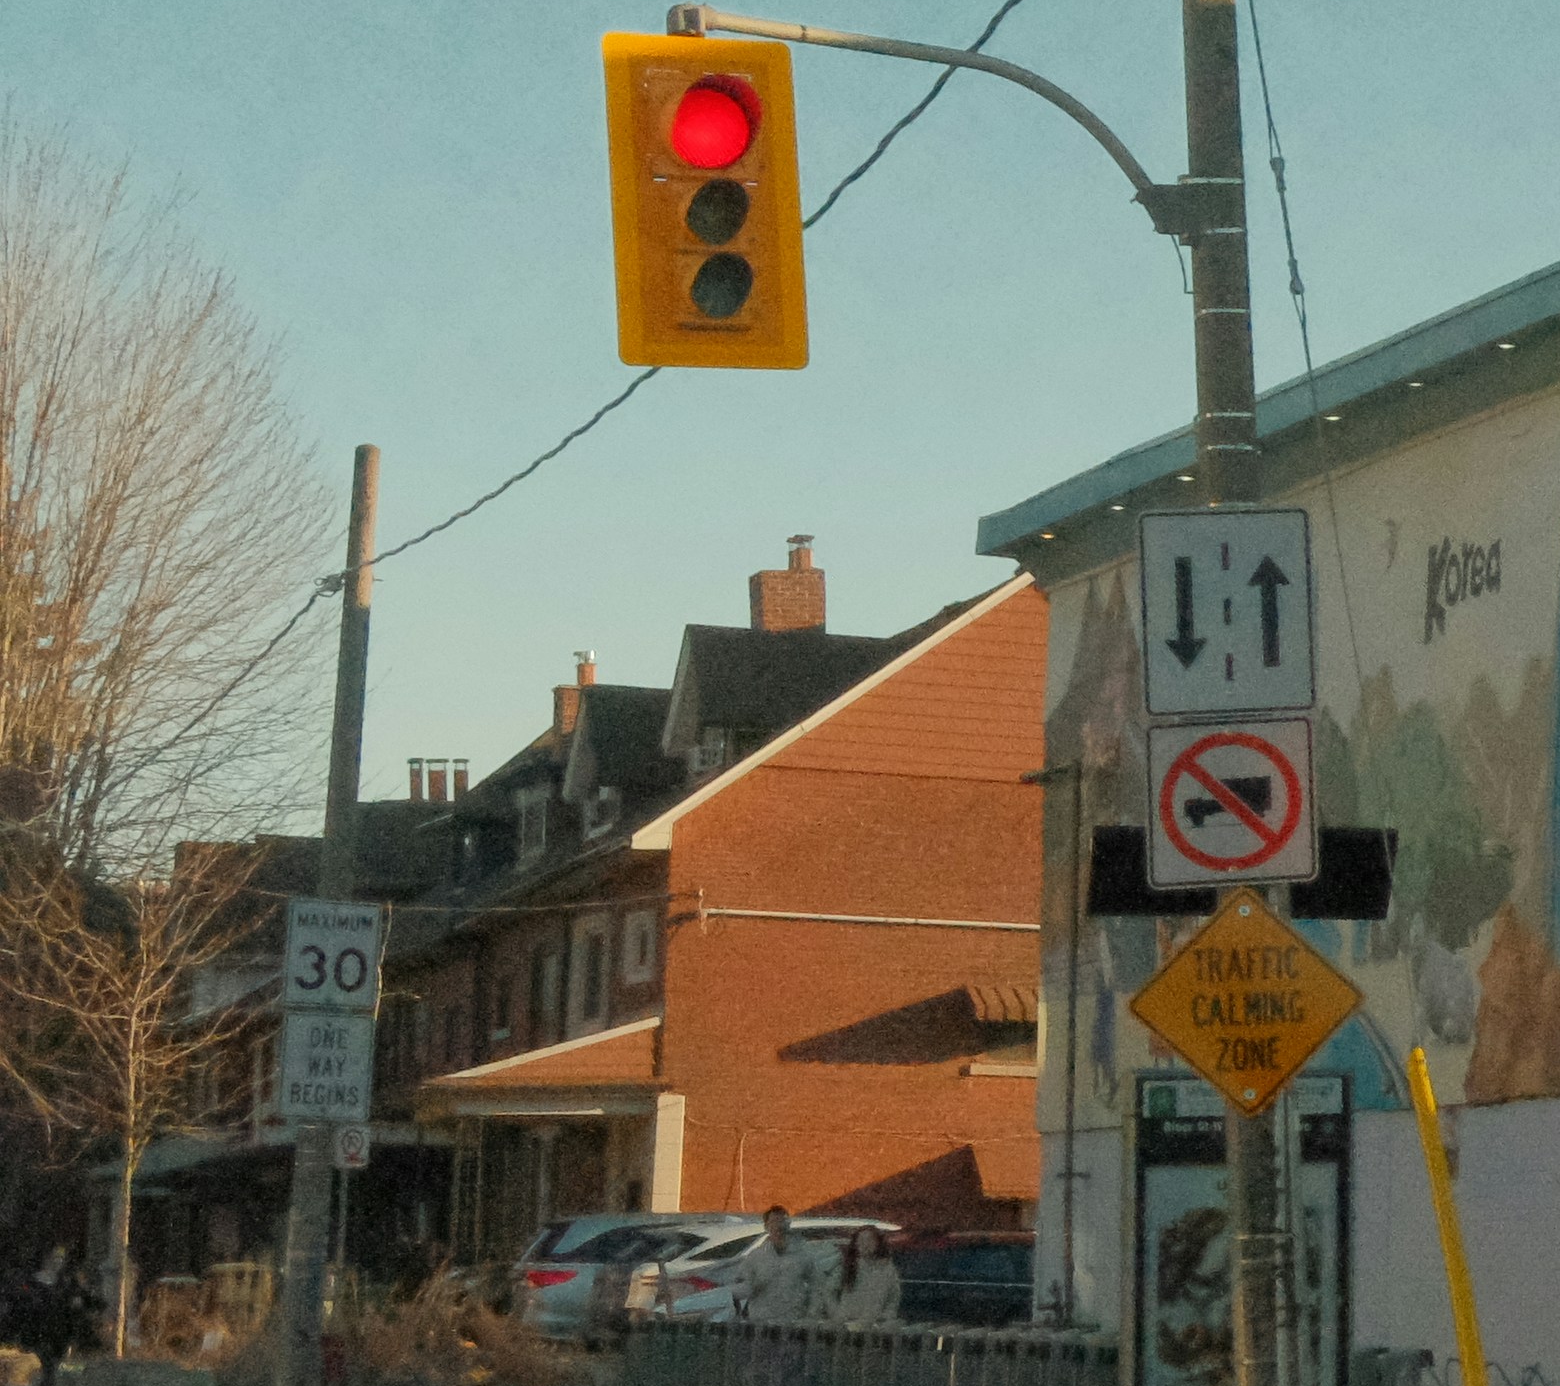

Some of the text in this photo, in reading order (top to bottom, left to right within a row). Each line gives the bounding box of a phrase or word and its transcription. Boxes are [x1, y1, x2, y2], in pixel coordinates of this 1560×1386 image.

[1422, 536, 1502, 645] Korea
[297, 913, 374, 932] MAXIMUM
[294, 944, 368, 994] 30
[1194, 944, 1300, 983] TRAFFIC
[1191, 989, 1304, 1029] CALMING
[309, 1027, 349, 1050] ONE
[1215, 1035, 1281, 1072] ZONE
[308, 1055, 347, 1078] WAY
[289, 1081, 359, 1106] BEGINS
